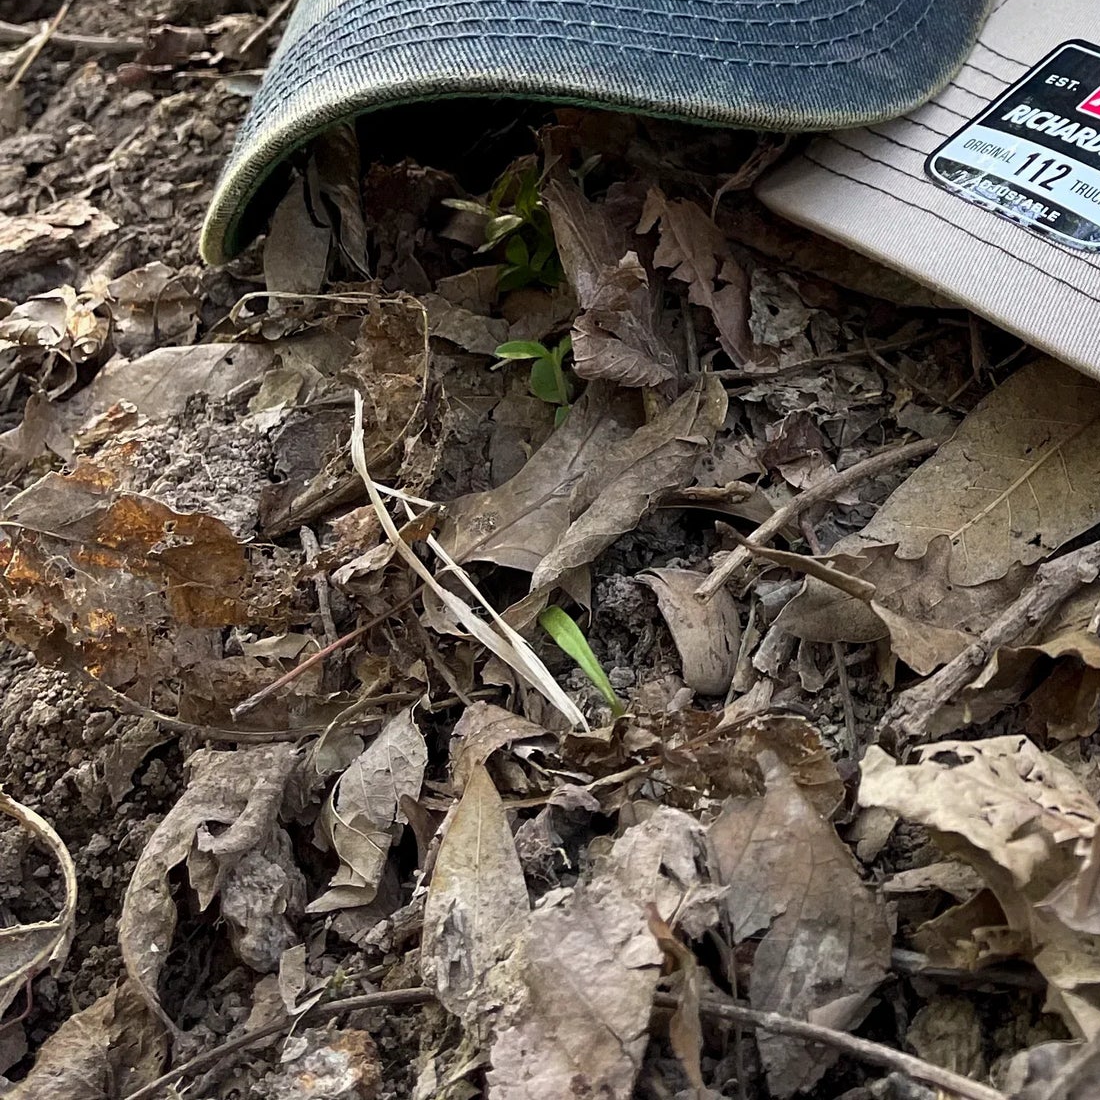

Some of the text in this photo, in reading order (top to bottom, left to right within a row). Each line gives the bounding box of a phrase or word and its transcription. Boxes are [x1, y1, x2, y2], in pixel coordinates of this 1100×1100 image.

[1045, 75, 1080, 91] EST.
[963, 138, 1016, 164] ORIGINAL
[1014, 152, 1072, 192] 112
[971, 176, 1060, 221] ADJUSTABLE
